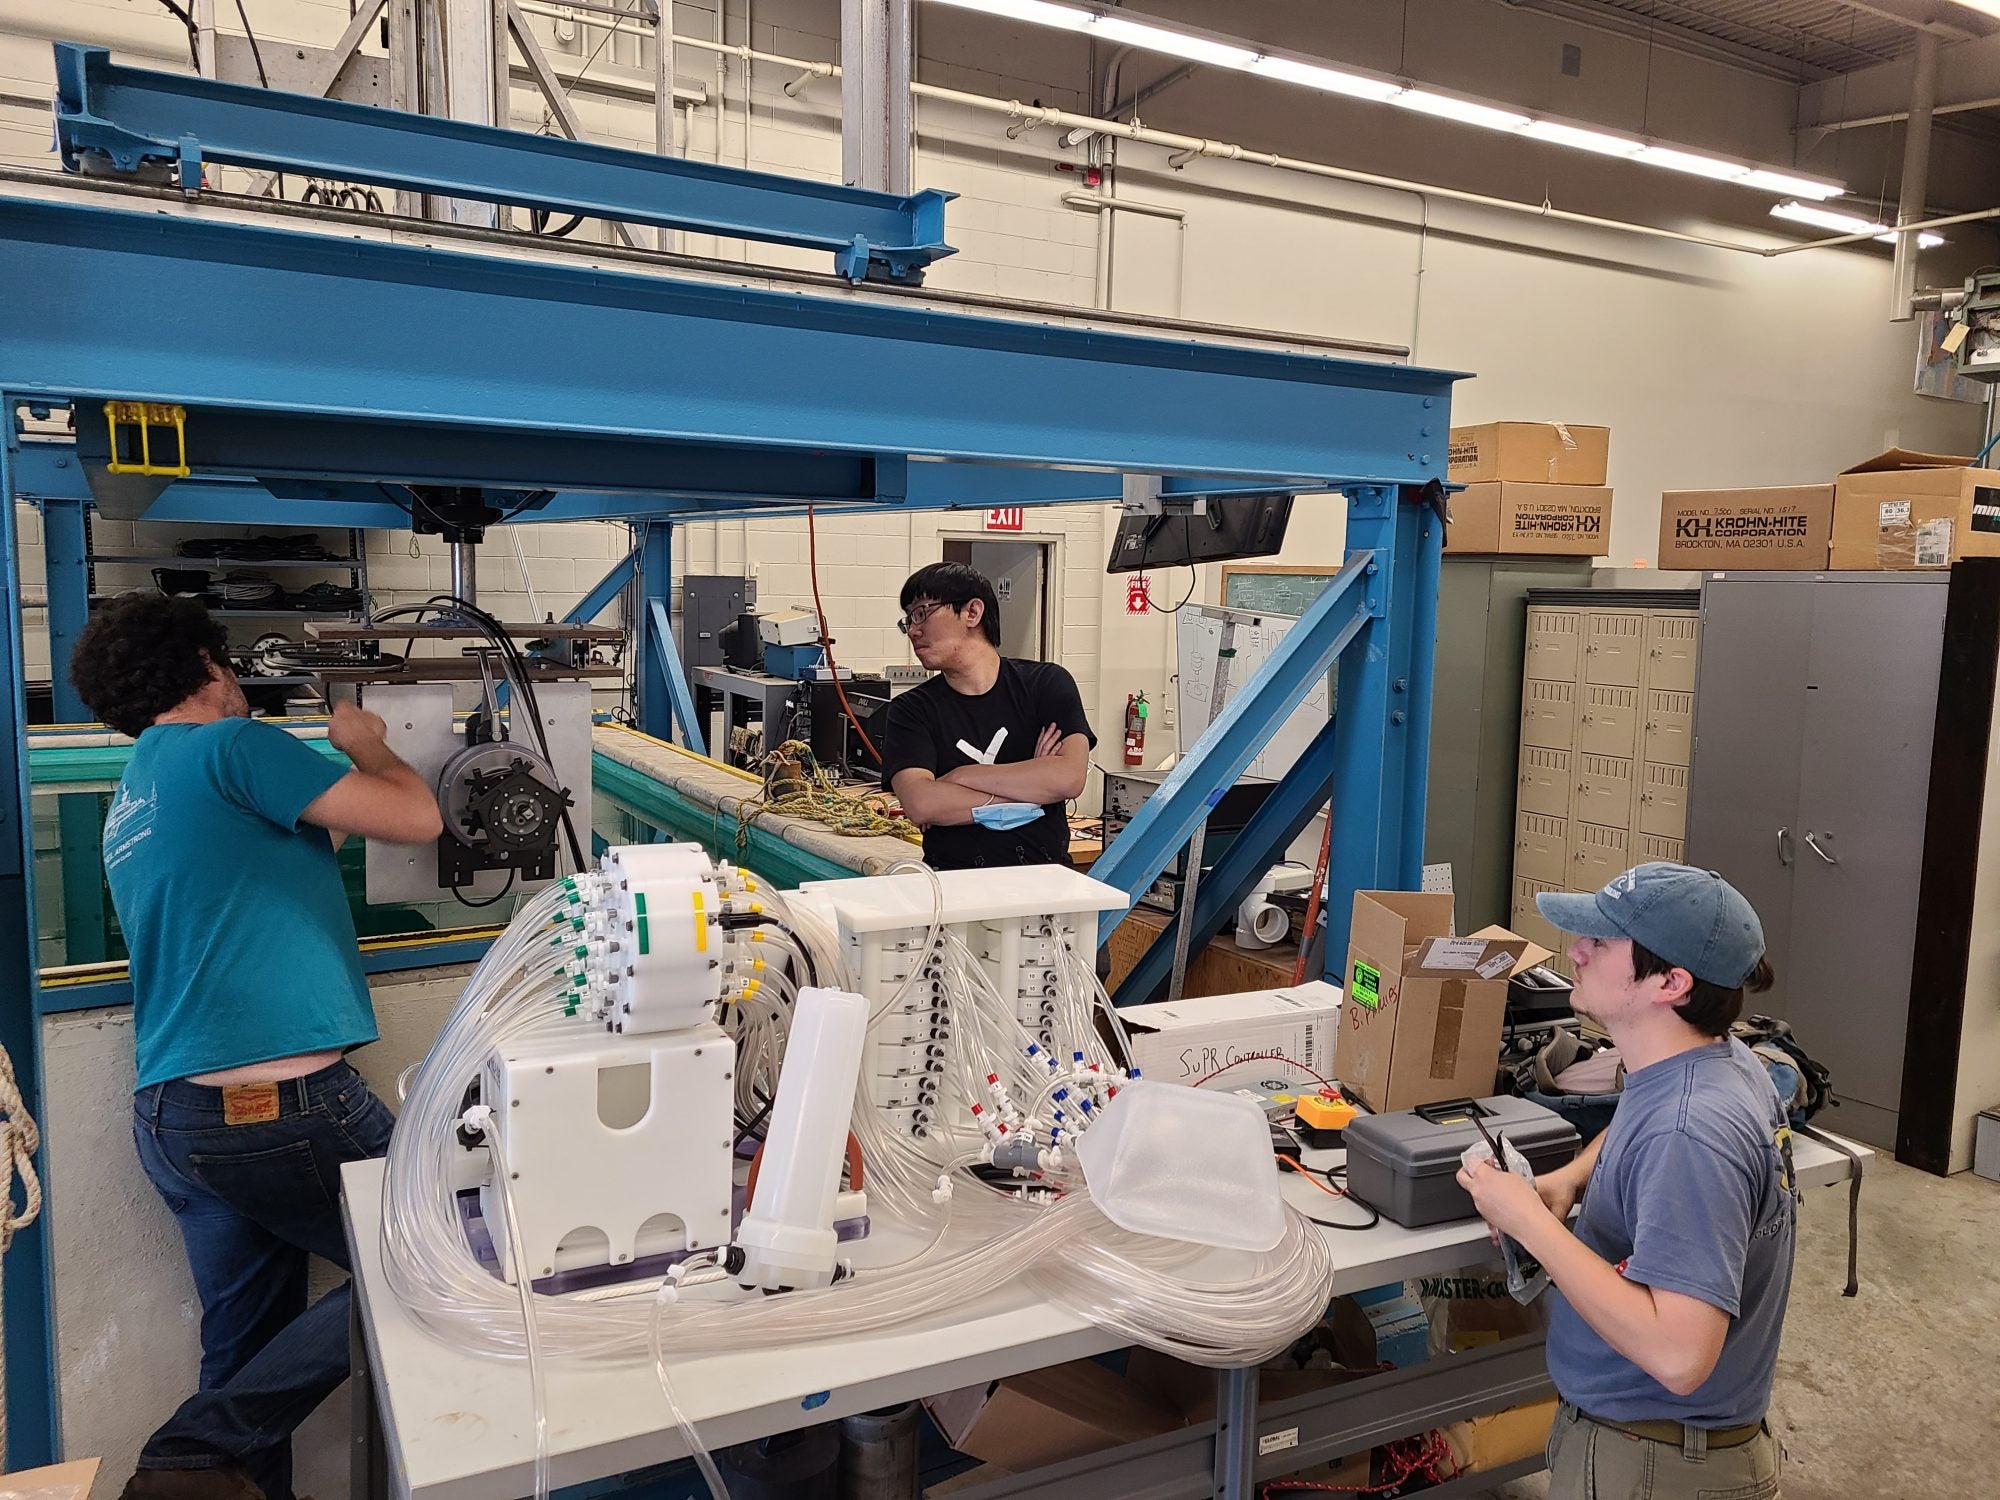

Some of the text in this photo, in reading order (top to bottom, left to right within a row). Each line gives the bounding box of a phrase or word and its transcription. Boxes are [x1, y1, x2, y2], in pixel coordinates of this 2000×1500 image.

[1515, 513, 1575, 522] CORPORATION
[1715, 516, 1808, 529] KROHN-HITE
[1514, 520, 1575, 532] KROHN-HITE
[1714, 528, 1807, 537] CORPORATION
[1675, 539, 1806, 549] BROCKTON, MA 02301 U.S.A.
[114, 826, 152, 857] ARMSTRONG
